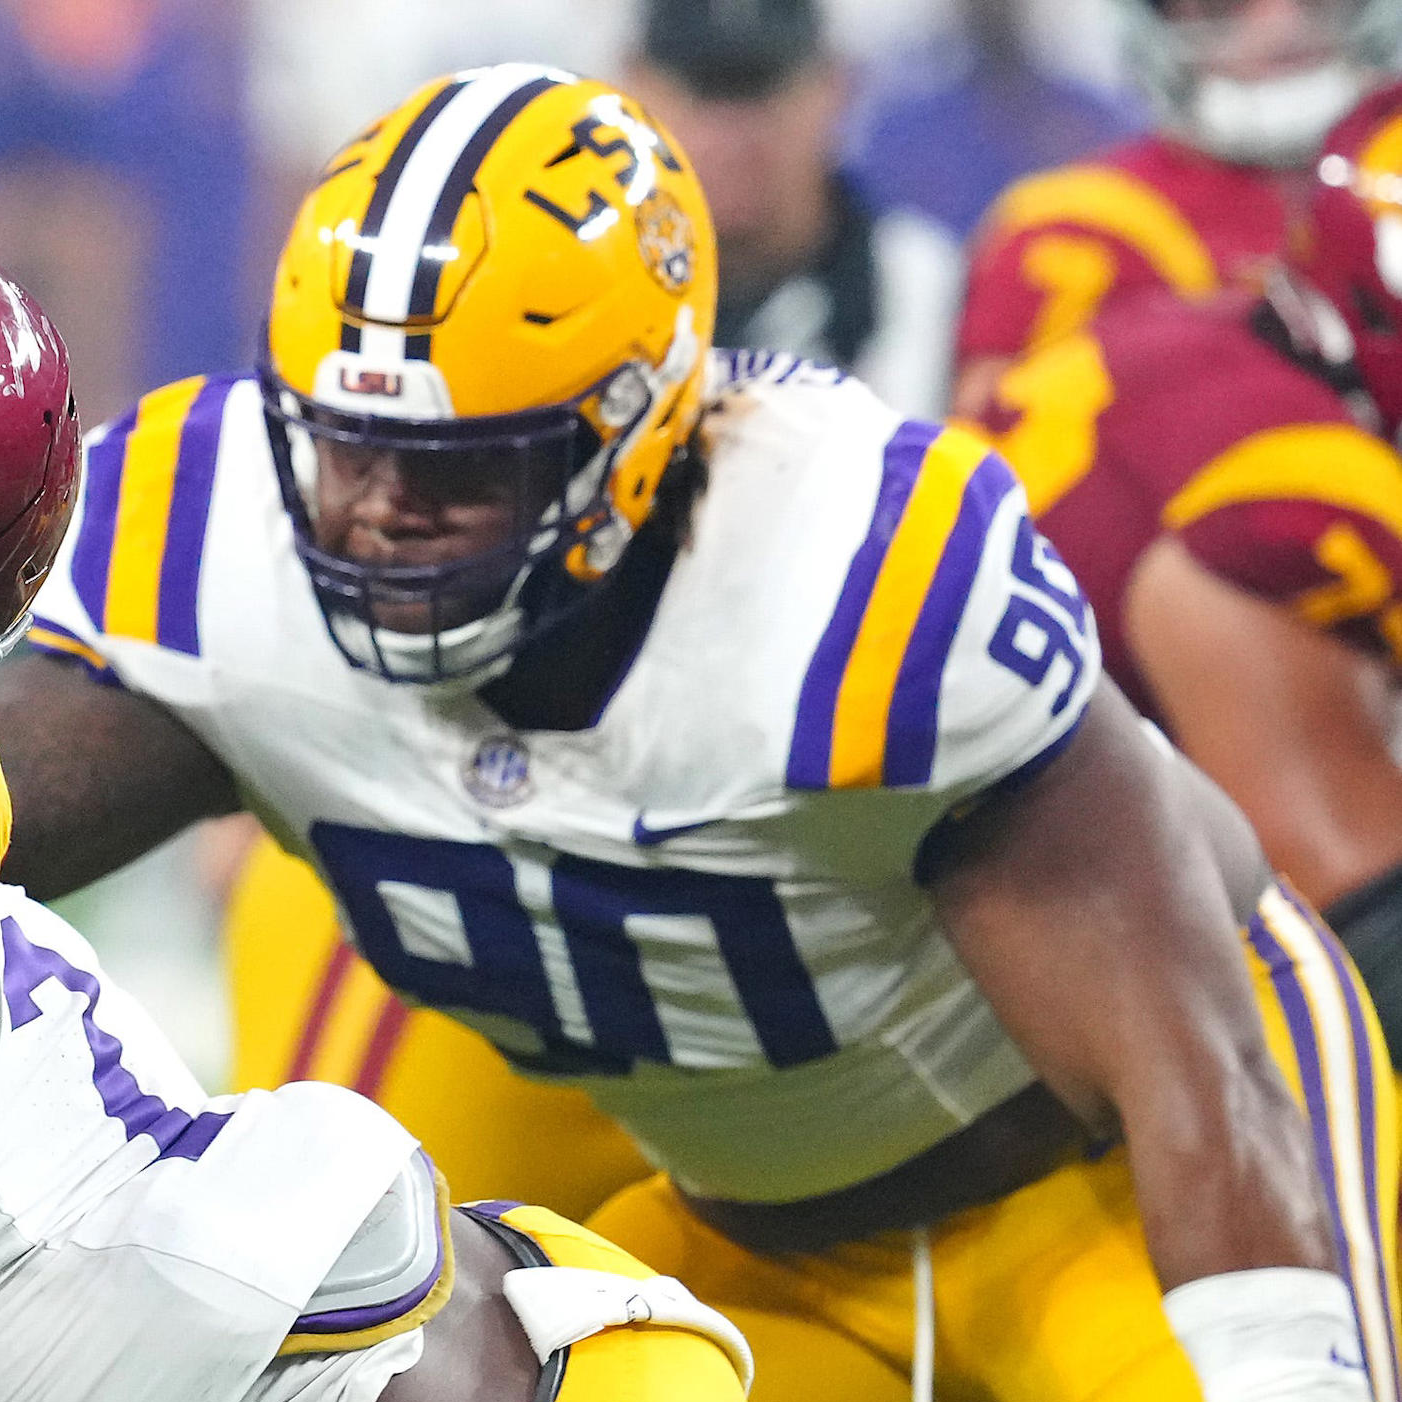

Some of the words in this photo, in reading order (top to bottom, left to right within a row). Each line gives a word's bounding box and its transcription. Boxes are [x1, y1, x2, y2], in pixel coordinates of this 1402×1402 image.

[340, 367, 404, 398] LSU
[988, 515, 1088, 717] 90
[309, 819, 839, 1077] 90
